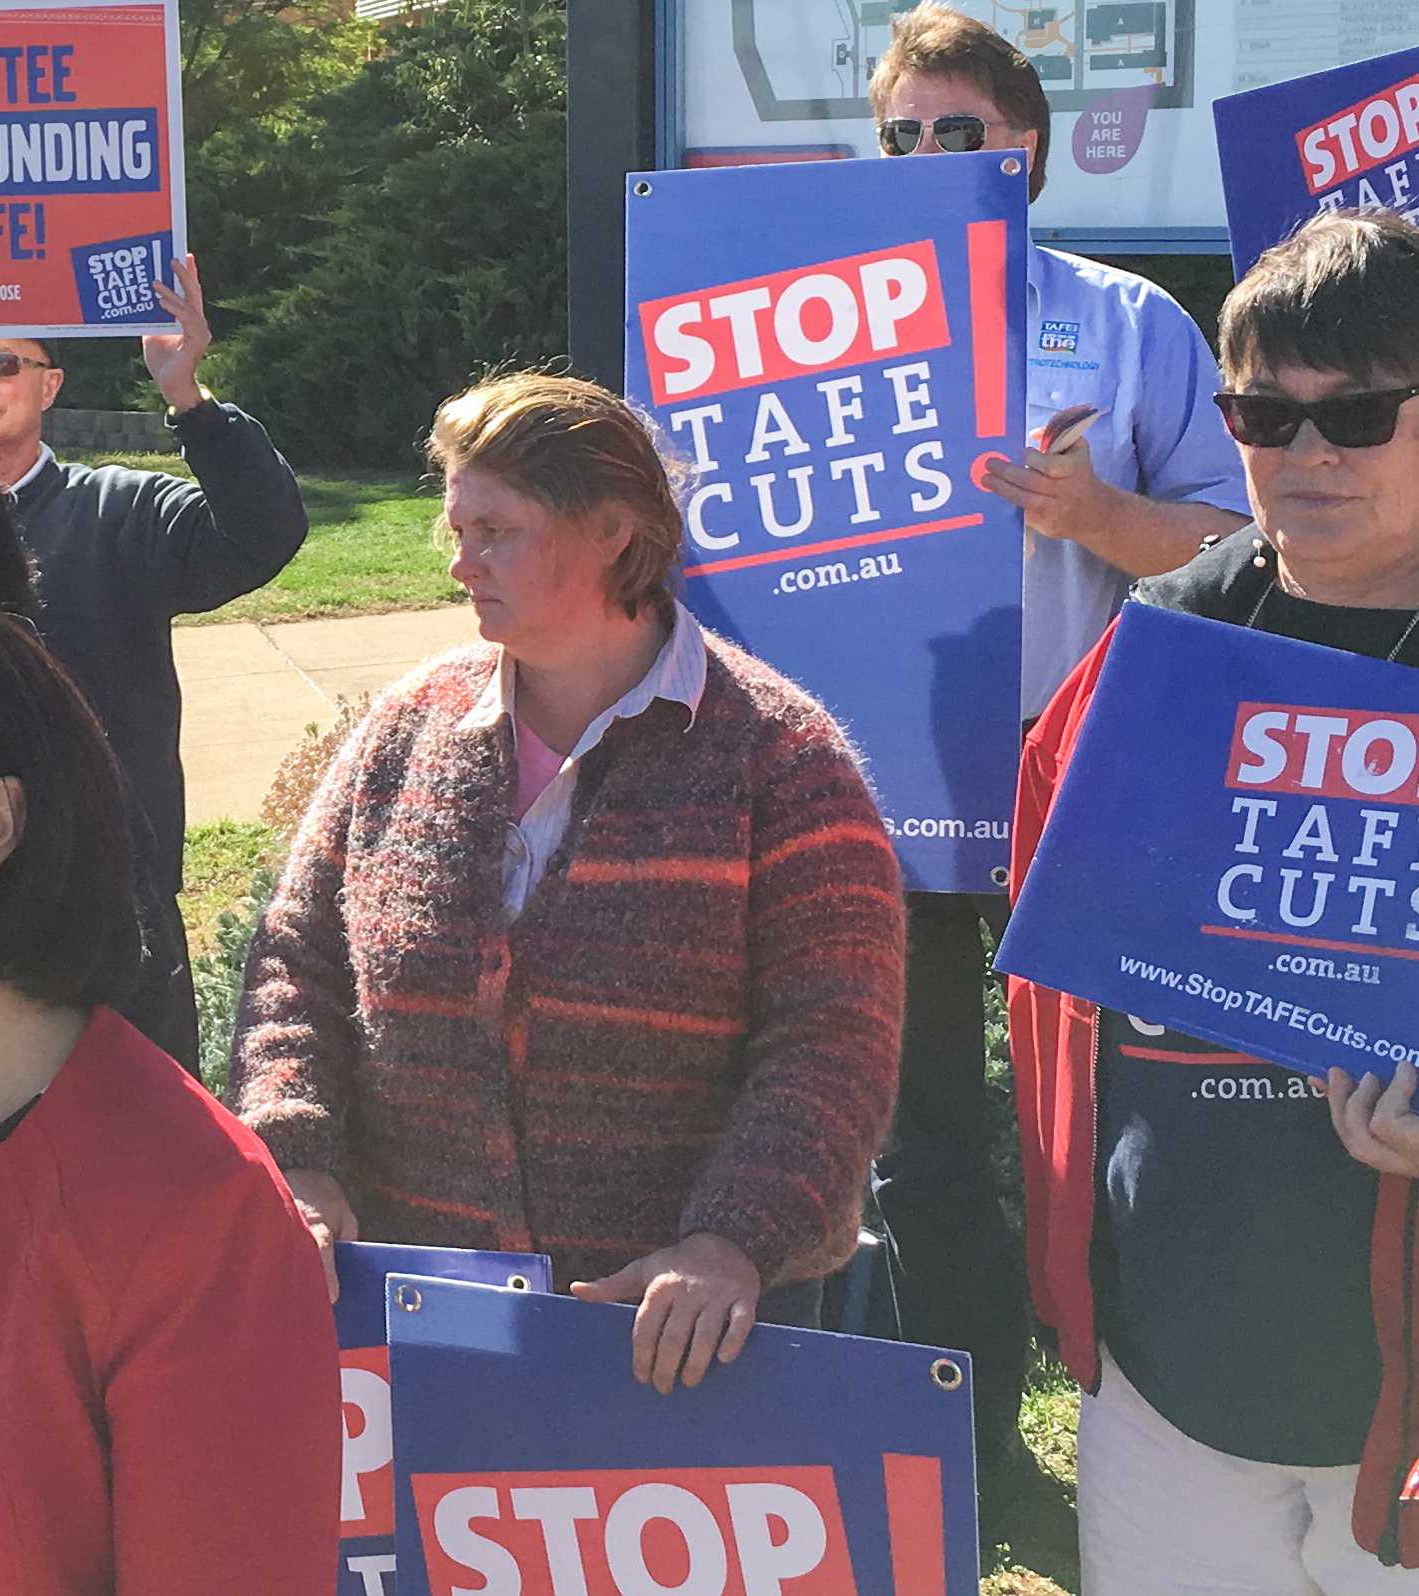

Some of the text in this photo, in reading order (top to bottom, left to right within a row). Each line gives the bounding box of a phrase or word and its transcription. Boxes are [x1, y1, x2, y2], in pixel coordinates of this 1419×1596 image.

[1091, 112, 1122, 125] YOU
[1091, 129, 1121, 141] ARE
[1086, 145, 1126, 158] HERE
[88, 246, 147, 273] STOP
[93, 265, 147, 291] TAFE
[97, 283, 152, 309] CUTS
[101, 301, 154, 320] .com.au
[654, 258, 928, 394] STOP
[670, 361, 939, 474] TAFE
[688, 440, 953, 550] CUTS
[773, 553, 902, 594] .com.au
[1237, 711, 1419, 797] STO
[1232, 797, 1419, 870] TAF
[1268, 954, 1381, 984] .com.au
[434, 1482, 827, 1596] STOP
